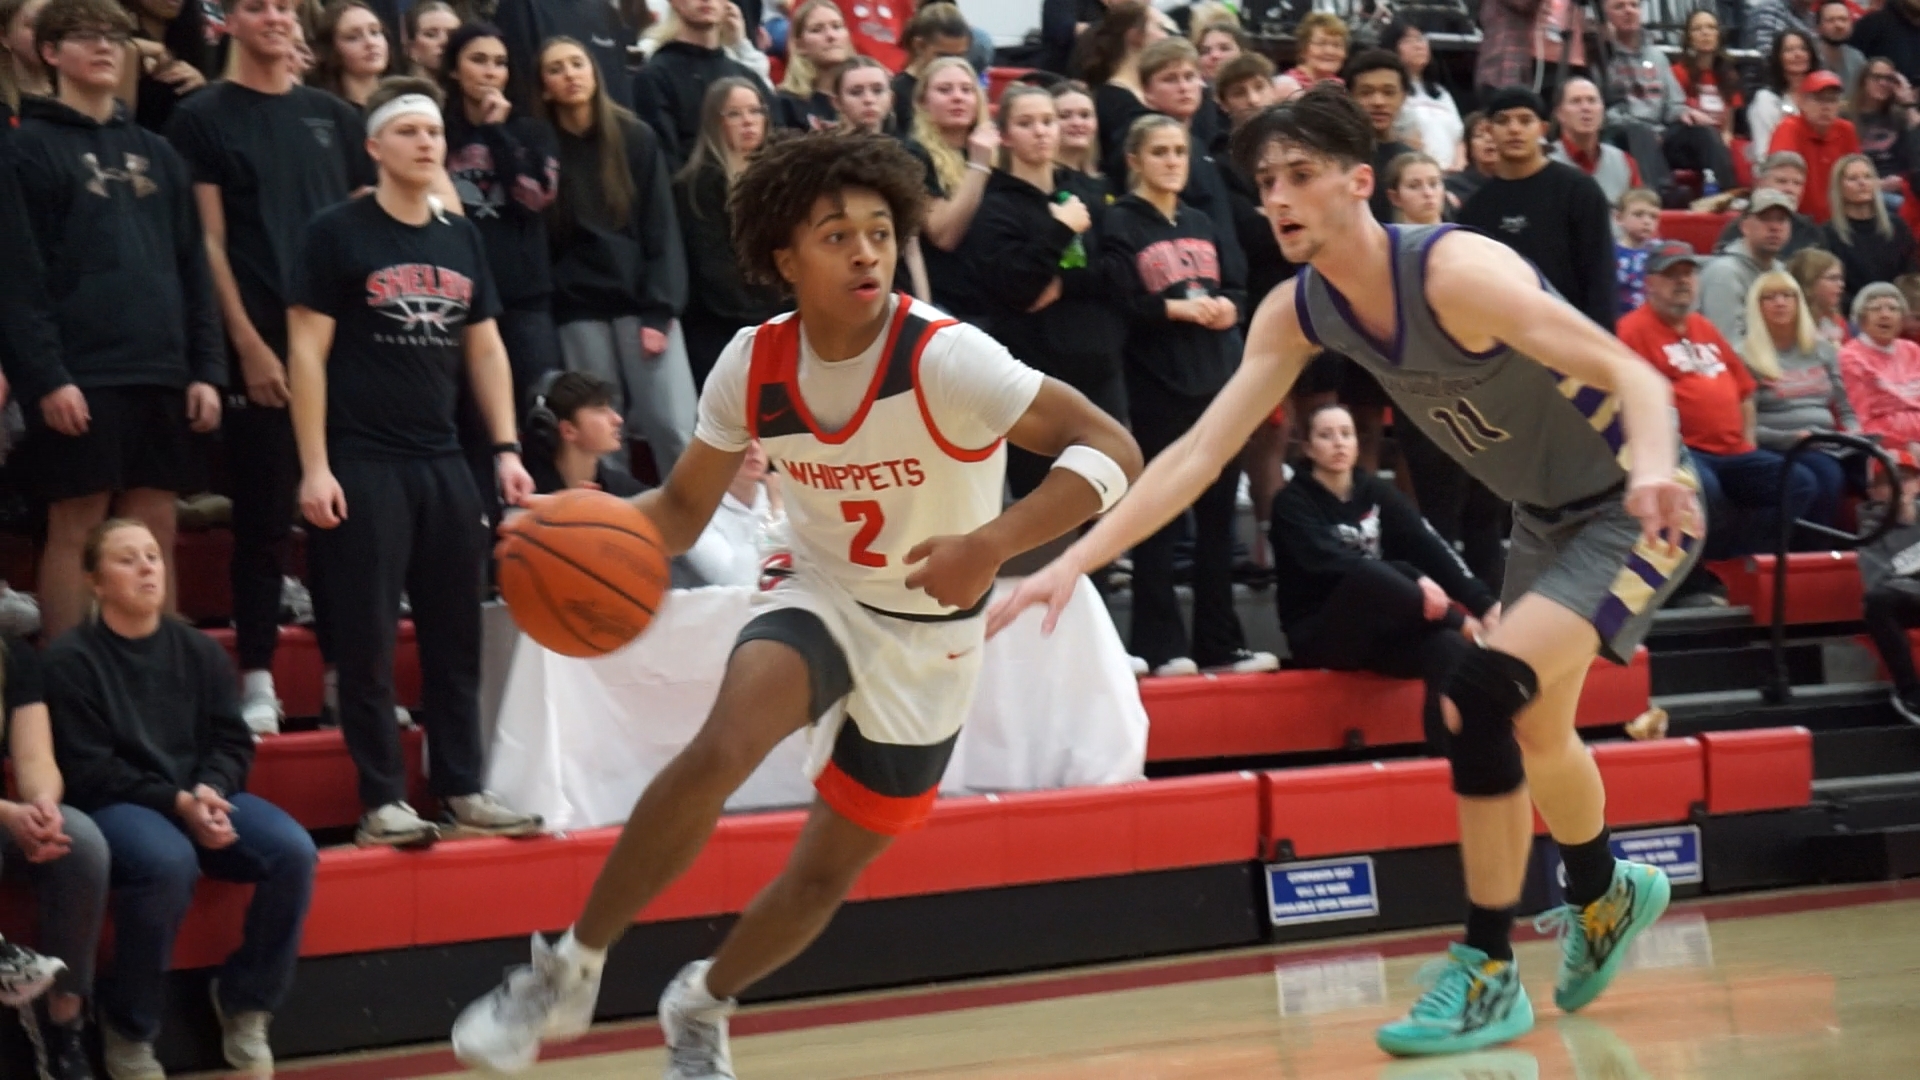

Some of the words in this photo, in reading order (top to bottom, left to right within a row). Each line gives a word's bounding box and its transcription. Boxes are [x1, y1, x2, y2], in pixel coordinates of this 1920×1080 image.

[366, 263, 474, 306] SHEL
[1428, 397, 1512, 457] 11
[780, 458, 925, 491] WHIPPETS
[840, 500, 887, 568] 2
